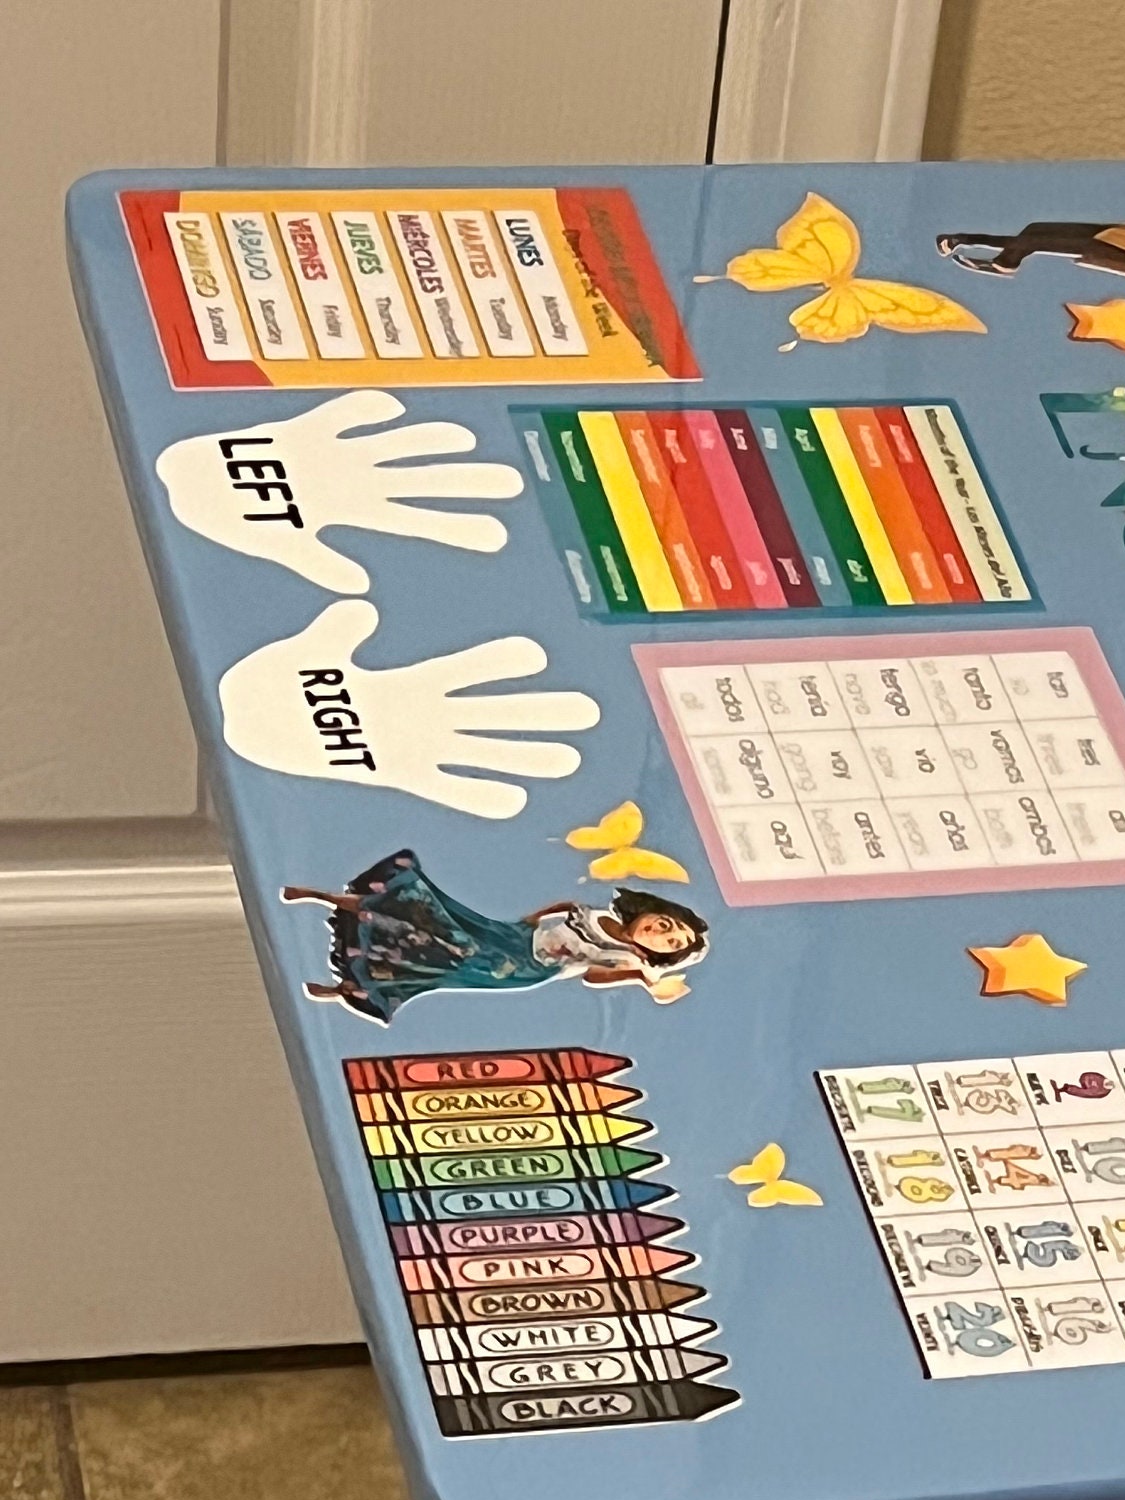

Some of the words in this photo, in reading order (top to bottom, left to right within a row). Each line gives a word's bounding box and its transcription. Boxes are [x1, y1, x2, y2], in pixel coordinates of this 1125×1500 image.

[173, 219, 222, 298] DOMINGO
[342, 220, 385, 274] JUEVES
[394, 214, 450, 293] MIÉRCOLES
[451, 218, 498, 279] MARTES
[284, 218, 329, 280] VIERNES
[318, 304, 347, 337] Friday
[503, 218, 546, 266] LUNES
[537, 295, 572, 340] Monday
[219, 438, 303, 528] LEFT
[711, 677, 749, 722] todos
[871, 668, 916, 717] tengo
[959, 667, 996, 710] tanto
[298, 669, 376, 770] RIGHT
[732, 739, 780, 799] alguno
[823, 750, 853, 780] voy
[986, 730, 1026, 783] vamos
[765, 820, 805, 860] aquí
[851, 811, 888, 859] antes
[1016, 796, 1060, 856] ambos
[437, 1061, 500, 1079] RED
[943, 1068, 1026, 1119] 13
[1045, 1070, 1117, 1101] 9
[425, 1092, 531, 1111] ORANGE
[844, 1076, 928, 1126] 17
[431, 1125, 539, 1144] YELLOW
[448, 1157, 549, 1178] GREEN
[872, 1148, 959, 1206] 18
[972, 1142, 1055, 1193] 14
[462, 1189, 551, 1210] BLUE
[462, 1223, 571, 1244] PURPLE
[902, 1227, 987, 1281] 19
[1002, 1218, 1087, 1271] 15
[484, 1258, 569, 1277] PINK
[481, 1291, 593, 1311] BROWN
[1032, 1294, 1118, 1348] 16
[492, 1325, 601, 1347] WHITE
[930, 1297, 1018, 1361] 20
[509, 1361, 604, 1382] GREY
[513, 1396, 623, 1418] BLACK
